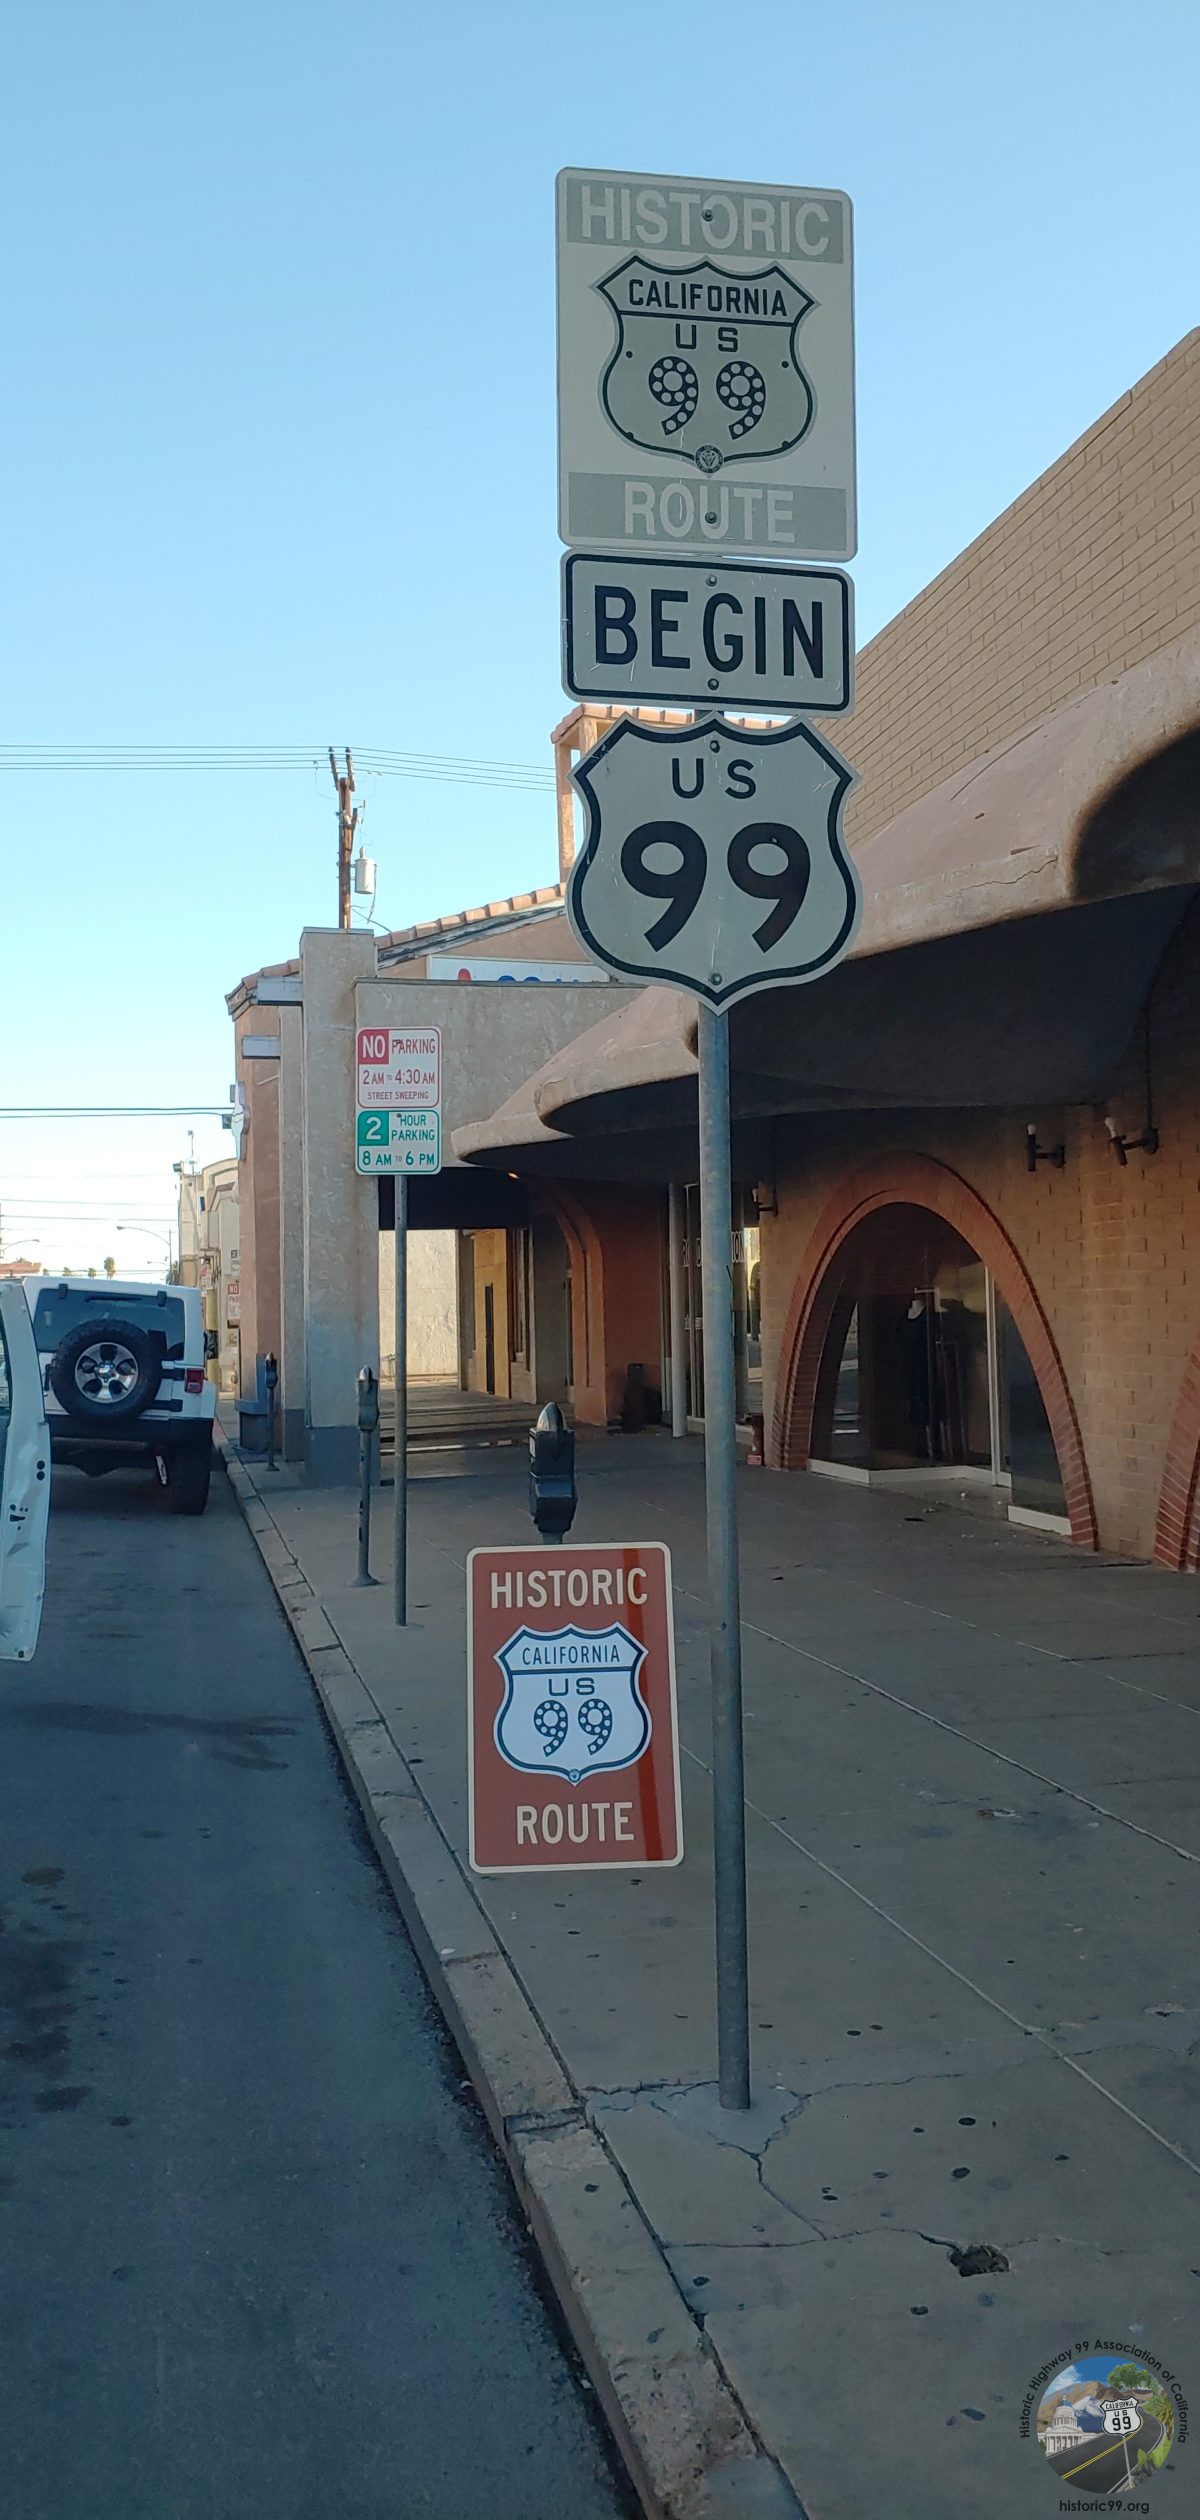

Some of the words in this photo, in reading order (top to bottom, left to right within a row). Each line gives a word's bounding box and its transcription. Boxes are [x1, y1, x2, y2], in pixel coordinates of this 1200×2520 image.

[581, 185, 829, 256] HISTORIC
[628, 278, 787, 317] CALIFORNIA
[648, 356, 766, 440] 99
[624, 481, 795, 543] ROUTE
[594, 584, 824, 679] BEGIN
[620, 820, 811, 953] 99
[362, 1034, 386, 1058] NO
[392, 1038, 436, 1054] PARKING
[363, 1069, 370, 1085] 2
[371, 1072, 385, 1085] AM
[395, 1068, 420, 1084] 4:30
[422, 1072, 435, 1084] AM
[367, 1091, 393, 1100] STREET
[395, 1091, 429, 1100] SWEEPING
[366, 1116, 382, 1140] 2
[400, 1114, 427, 1126] HOUR
[391, 1129, 436, 1141] PARKING
[362, 1150, 371, 1165] 8
[375, 1153, 392, 1165] AM
[405, 1151, 414, 1165] 6
[419, 1153, 435, 1165] PM
[491, 1568, 648, 1609] HISTORIC
[522, 1644, 620, 1666] CALIFORNIA
[548, 1677, 596, 1697] US
[533, 1698, 613, 1757] 99
[516, 1802, 635, 1845] ROUTE
